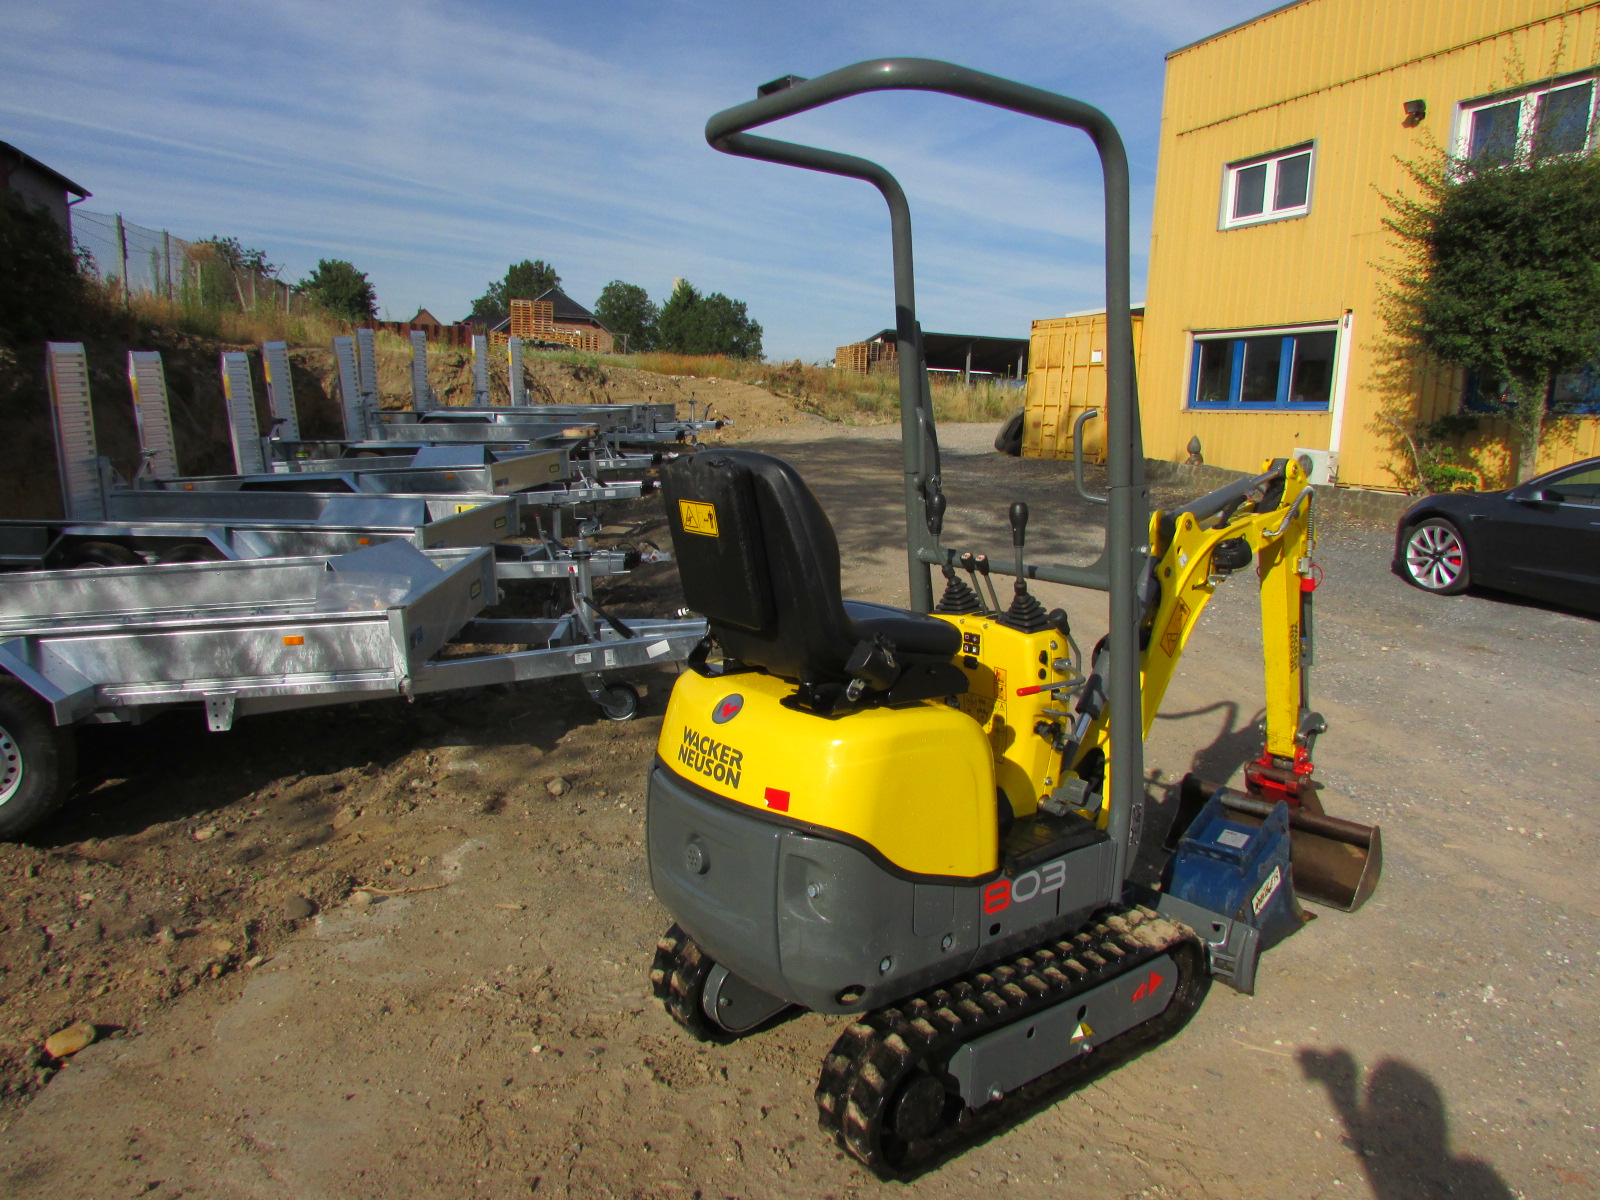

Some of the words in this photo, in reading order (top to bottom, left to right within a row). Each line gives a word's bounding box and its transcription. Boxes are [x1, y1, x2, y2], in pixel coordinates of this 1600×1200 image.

[678, 744, 741, 789] NEUSON
[683, 725, 743, 771] WACKER
[984, 860, 1066, 914] 803
